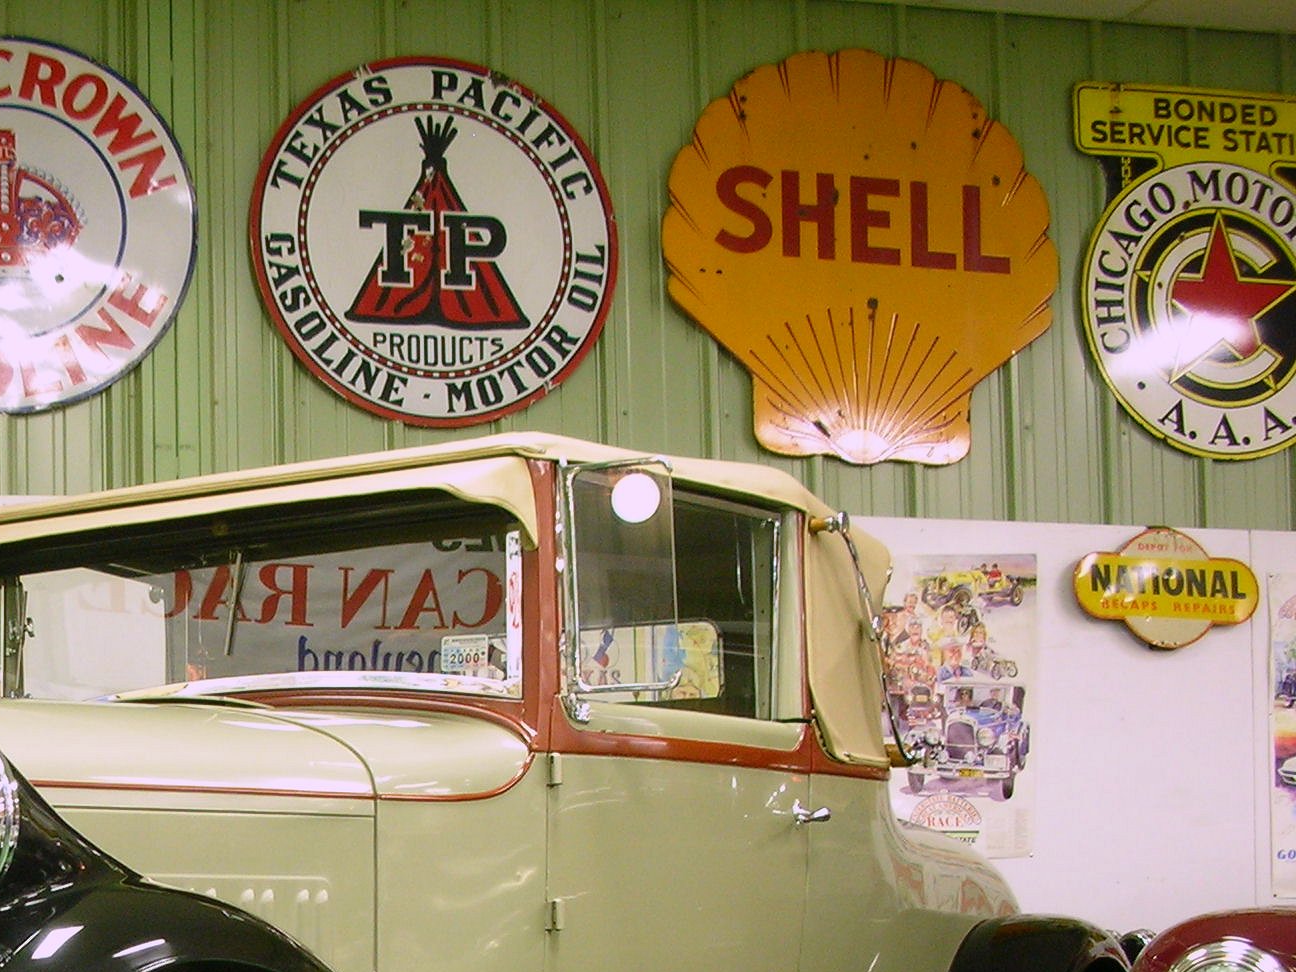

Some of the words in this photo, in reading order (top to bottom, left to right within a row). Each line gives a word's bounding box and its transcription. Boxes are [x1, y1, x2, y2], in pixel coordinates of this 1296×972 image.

[1153, 98, 1278, 127] BONDED
[270, 75, 394, 190] TEXAS
[430, 70, 594, 200] PACIFIC
[1091, 119, 1211, 150] SERVICE
[714, 164, 1011, 275] SHELL
[1094, 181, 1176, 355] CHICAGO
[1187, 168, 1296, 240] MOTO
[265, 232, 408, 407] GASOLINE
[445, 323, 582, 413] MOTOR
[568, 244, 605, 313] OIL
[372, 332, 505, 367] PRODUCTS
[1091, 563, 1247, 600] NATIONAL
[1173, 601, 1236, 615] REPAIRS
[449, 652, 480, 665] 2000
